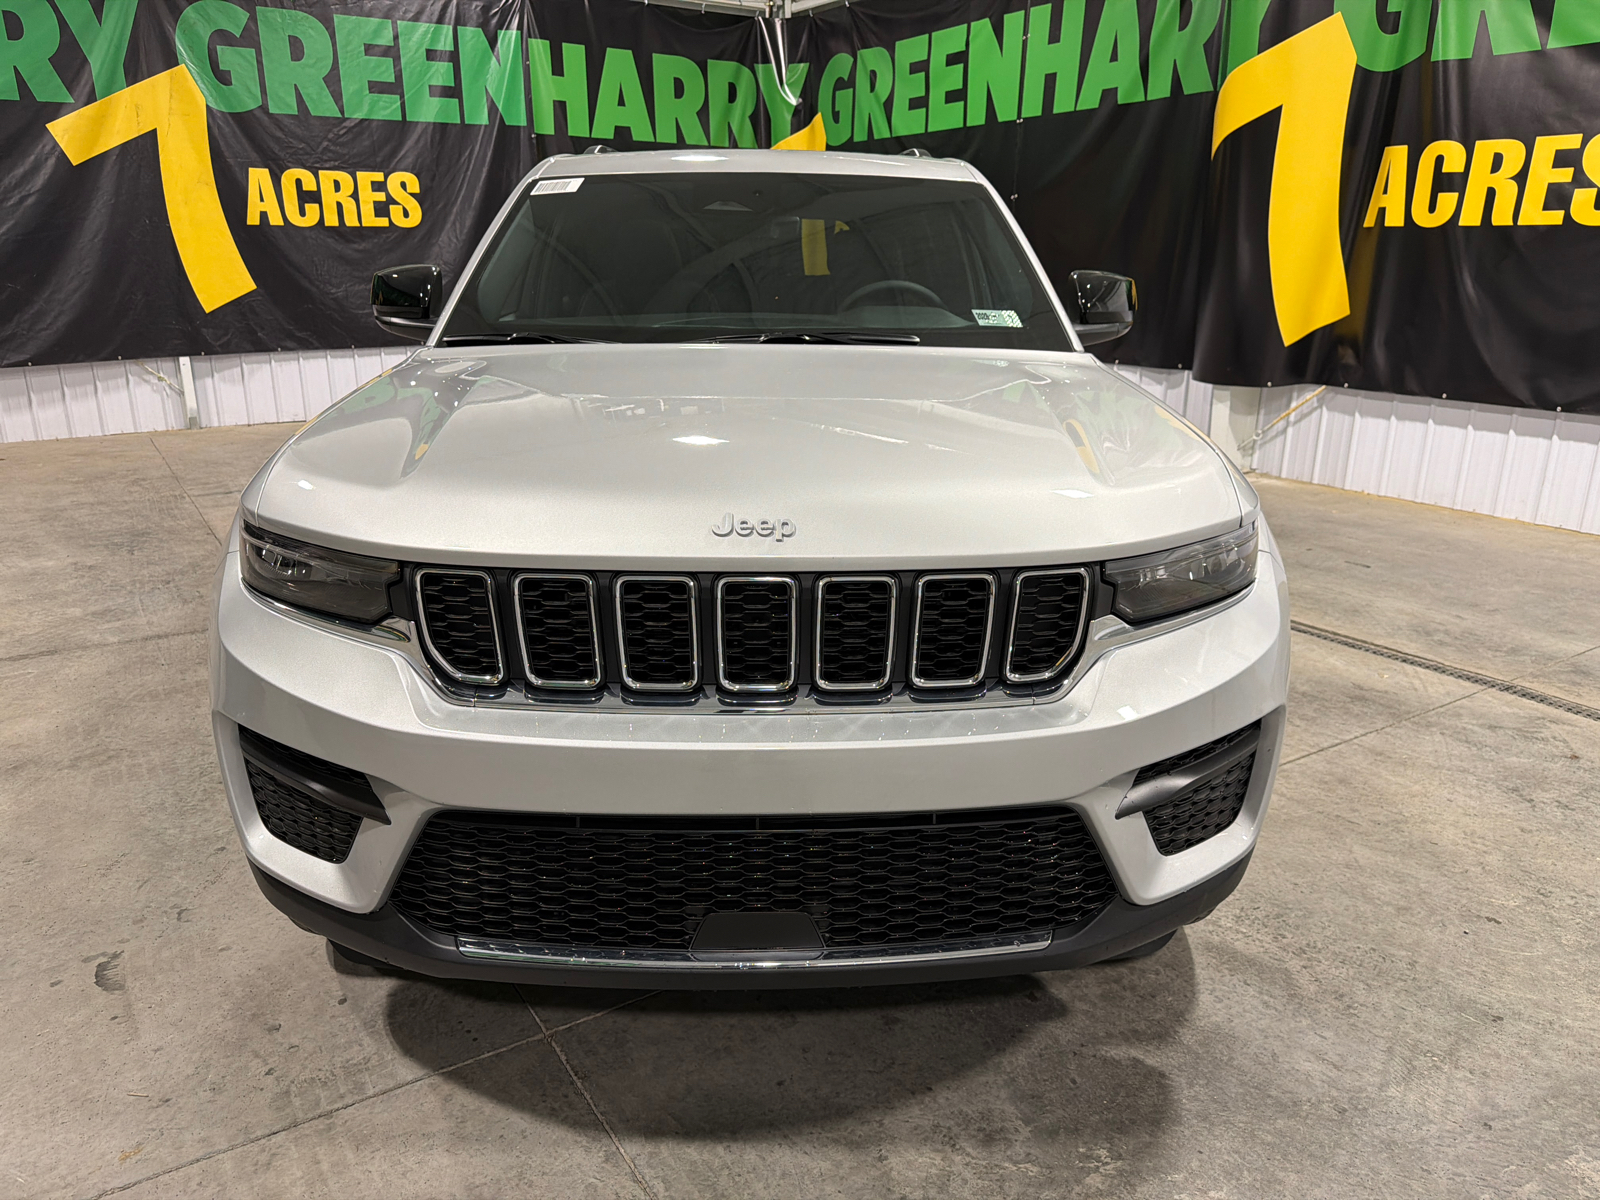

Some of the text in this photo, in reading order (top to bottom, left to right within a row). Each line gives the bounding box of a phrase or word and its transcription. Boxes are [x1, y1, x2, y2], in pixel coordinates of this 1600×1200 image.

[175, 0, 528, 126] GREEN
[528, 10, 1025, 149] HARRY GREEN
[1021, 0, 1273, 118] HAR
[45, 63, 423, 314] 7 ACRES
[1211, 11, 1358, 347] 7
[711, 512, 797, 542] Jeep
